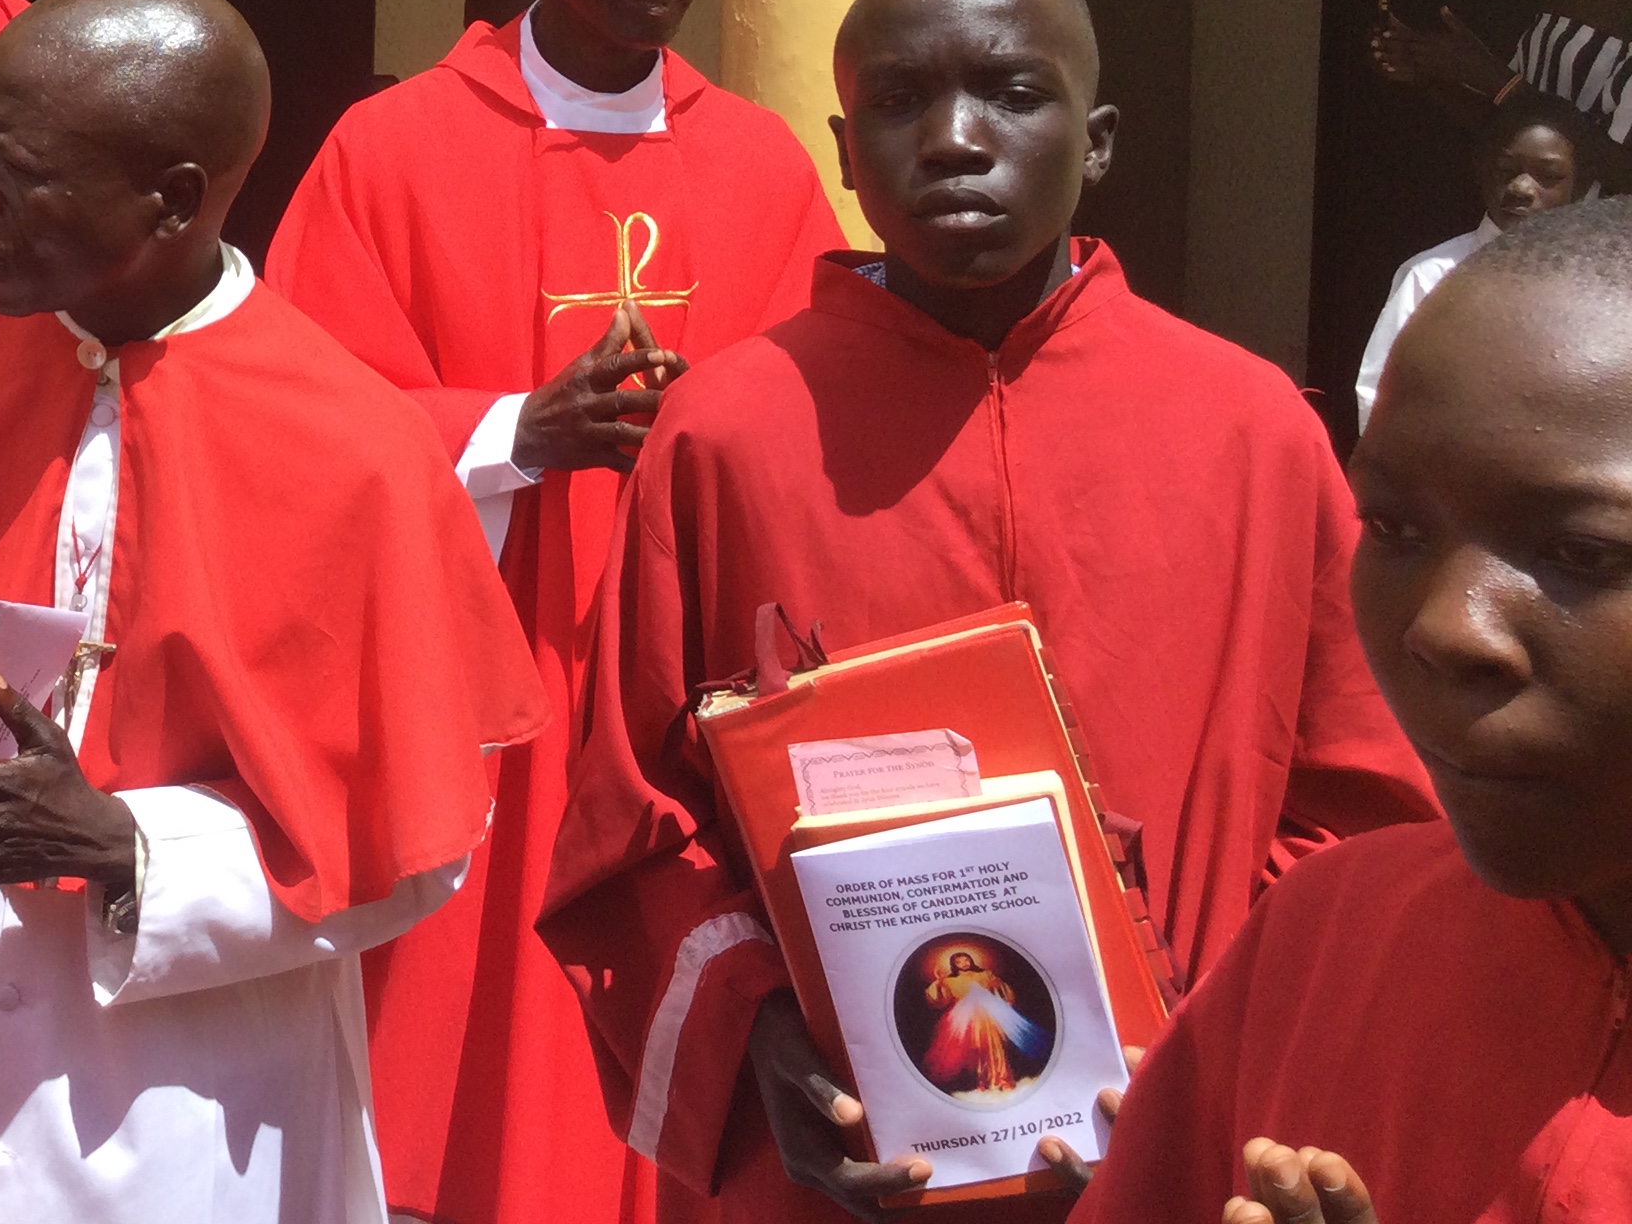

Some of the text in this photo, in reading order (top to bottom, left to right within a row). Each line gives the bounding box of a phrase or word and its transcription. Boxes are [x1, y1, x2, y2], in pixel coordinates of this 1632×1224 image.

[867, 766, 885, 775] FOR
[886, 764, 904, 773] THE
[825, 871, 1029, 908] COMMUNION, CONFIRMATION AND
[835, 881, 876, 894] ORDER
[878, 878, 894, 889] OF
[897, 874, 930, 887] MASS
[932, 870, 957, 882] FOR
[978, 860, 1011, 875] HOLY
[829, 894, 1041, 933] CHRIST THE KING PRIMARY SCHOOL
[842, 885, 1019, 919] BLESSING OF CANDIDATES AT
[911, 1111, 1085, 1153] THURSDAY 27/10/2022
